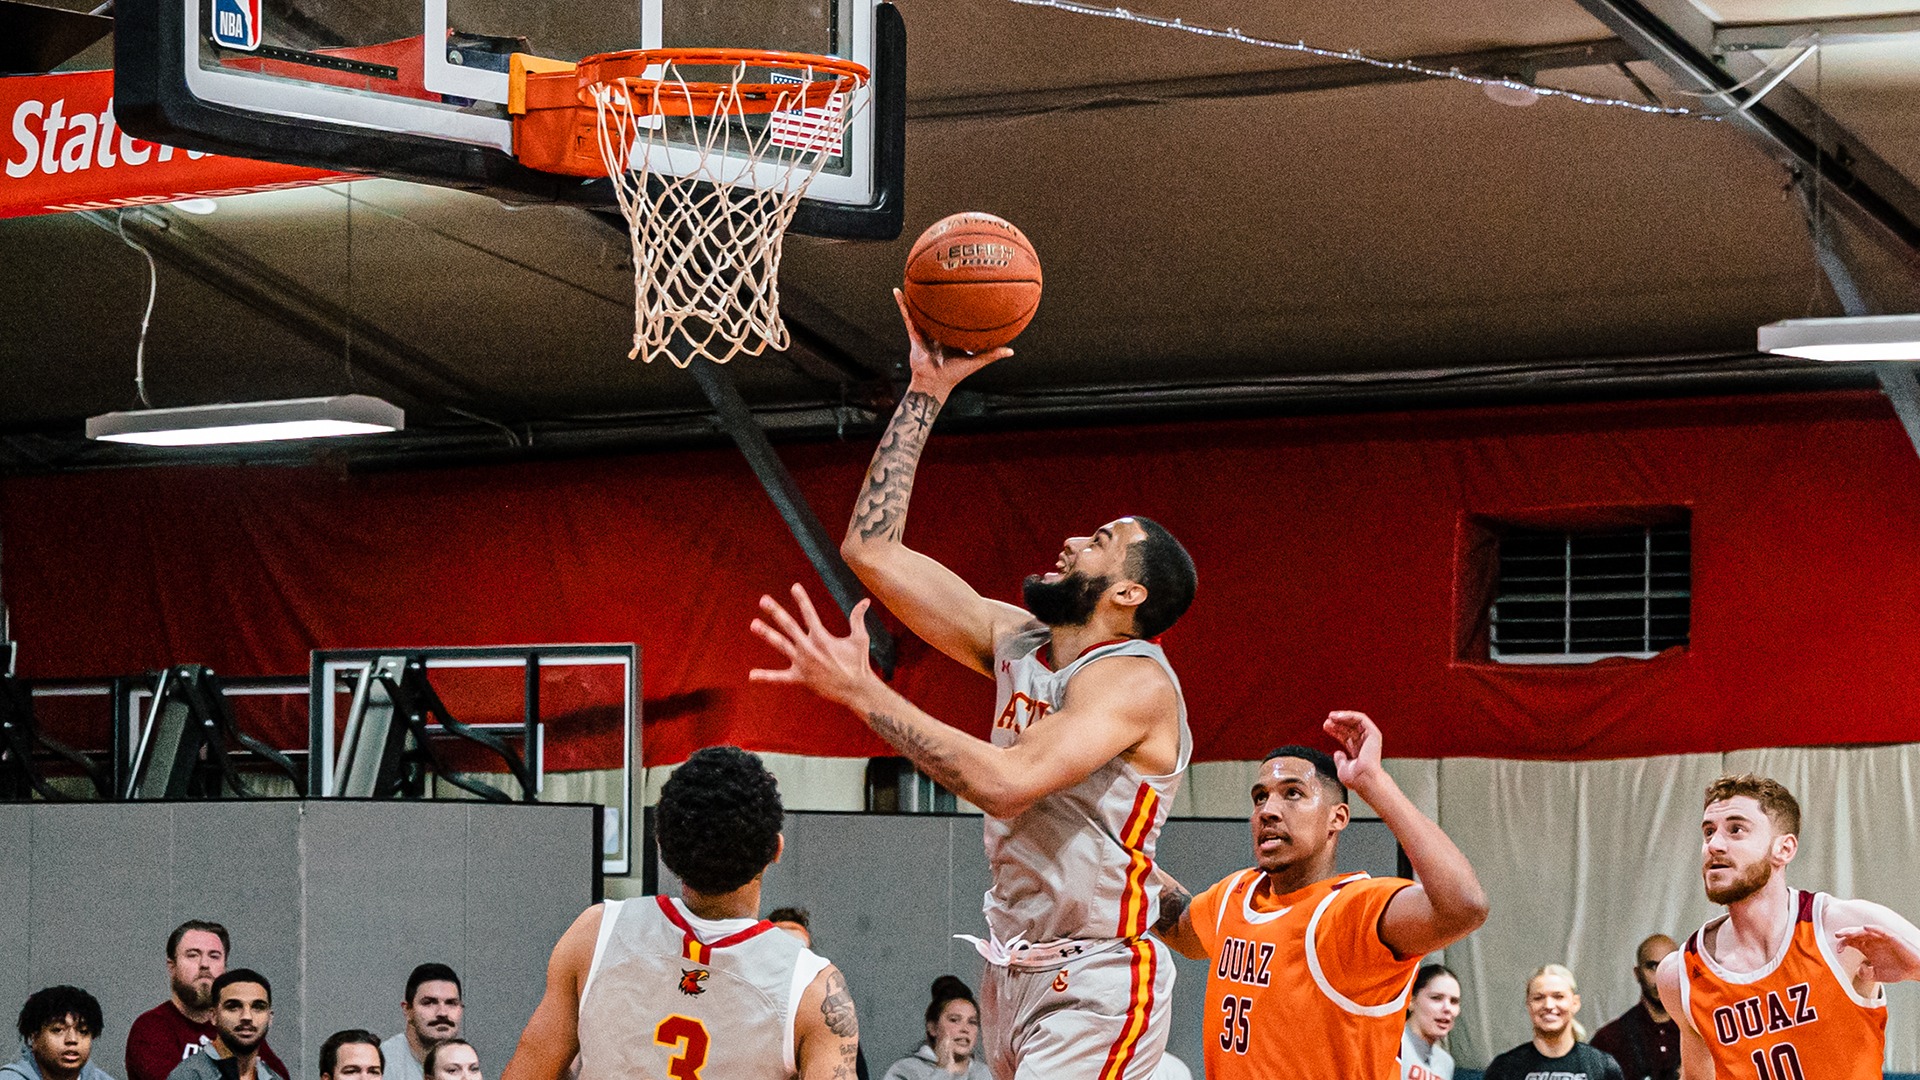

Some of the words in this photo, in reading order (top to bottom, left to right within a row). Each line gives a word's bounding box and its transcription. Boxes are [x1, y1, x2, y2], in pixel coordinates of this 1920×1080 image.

[220, 10, 244, 39] NBA
[1217, 936, 1276, 988] OUAZ
[1219, 994, 1253, 1056] 35
[1712, 982, 1819, 1047] OUAZ
[653, 1012, 711, 1080] 3
[1750, 1042, 1805, 1080] 10
